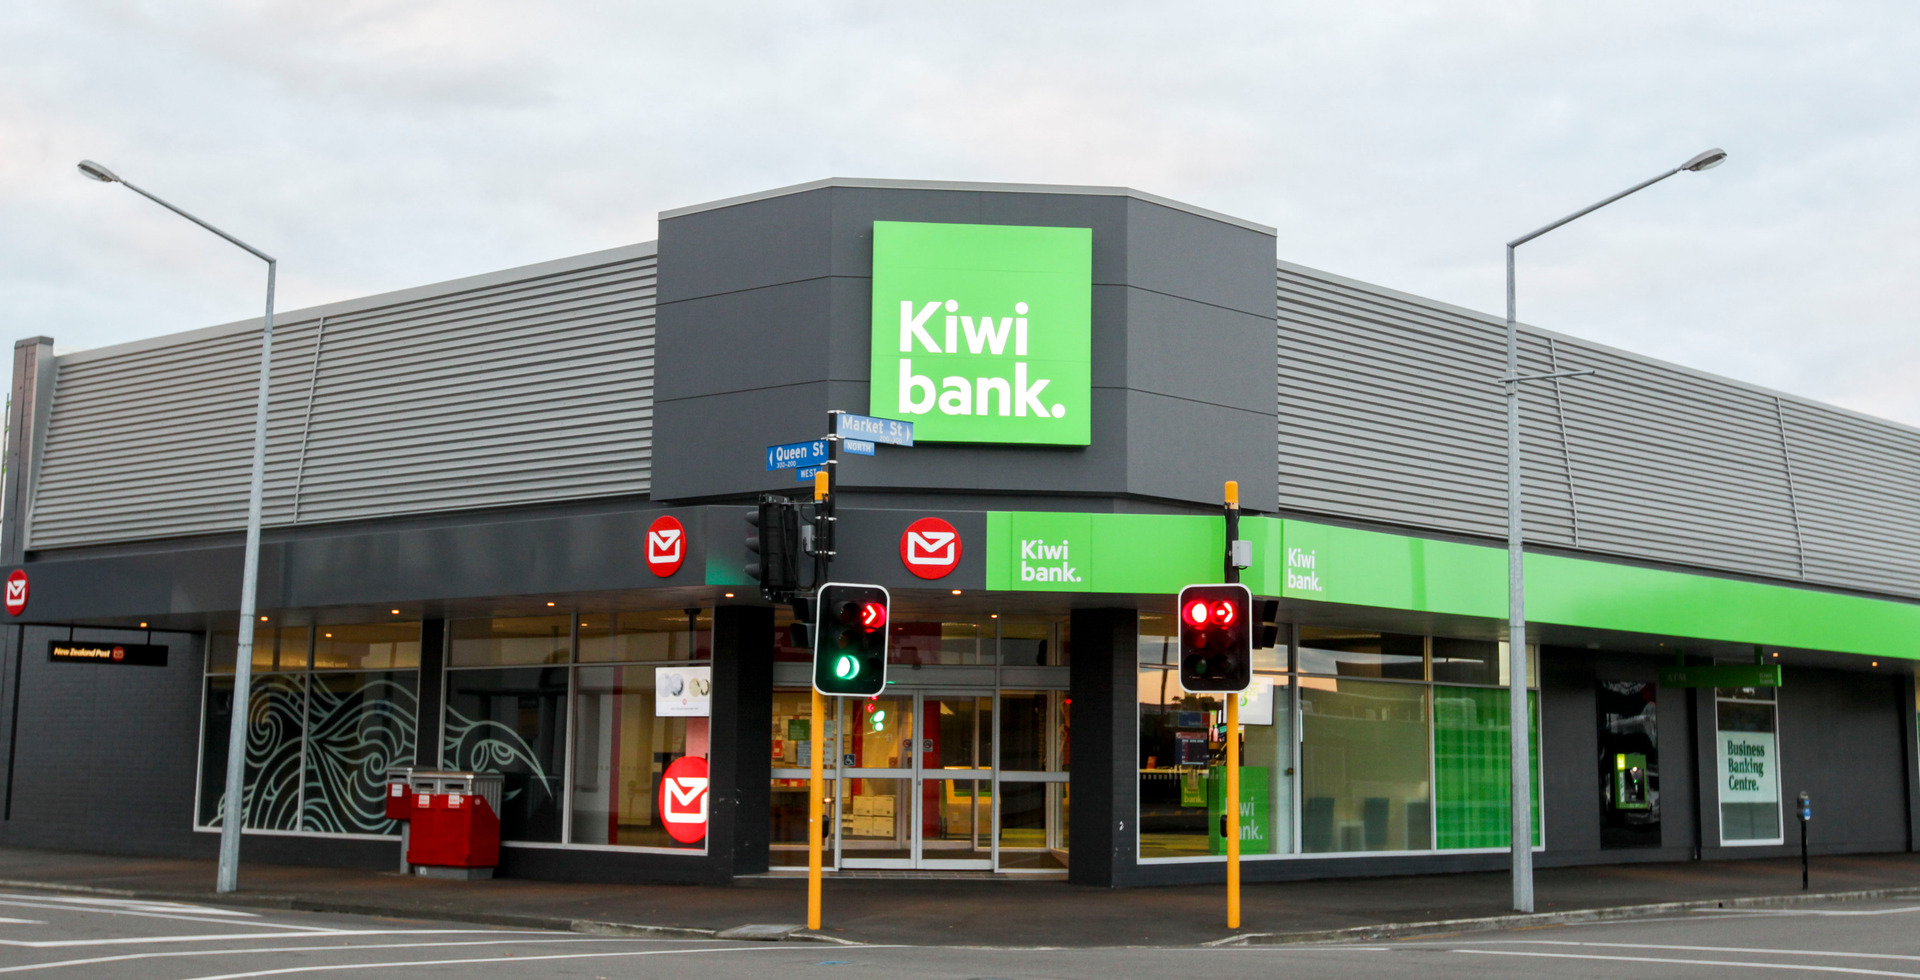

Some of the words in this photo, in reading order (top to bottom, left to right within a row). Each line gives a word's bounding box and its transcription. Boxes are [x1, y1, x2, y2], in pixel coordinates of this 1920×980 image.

[899, 299, 1029, 356] Kiwi
[898, 358, 1066, 419] bank.
[842, 415, 884, 434] Market
[890, 421, 903, 436] St
[776, 446, 807, 461] Queen
[812, 442, 824, 457] St
[847, 442, 872, 453] NORTH
[800, 468, 817, 478] WEST
[1021, 539, 1069, 560] Kiwi
[1288, 547, 1316, 569] Kiwi
[1021, 560, 1082, 583] bank.
[1288, 568, 1323, 592] bank.
[53, 647, 69, 656] New
[69, 647, 96, 657] Zealand
[95, 648, 111, 658] Post
[1727, 740, 1765, 757] Business
[1728, 757, 1764, 778] Banking
[1728, 775, 1760, 791] Centre.
